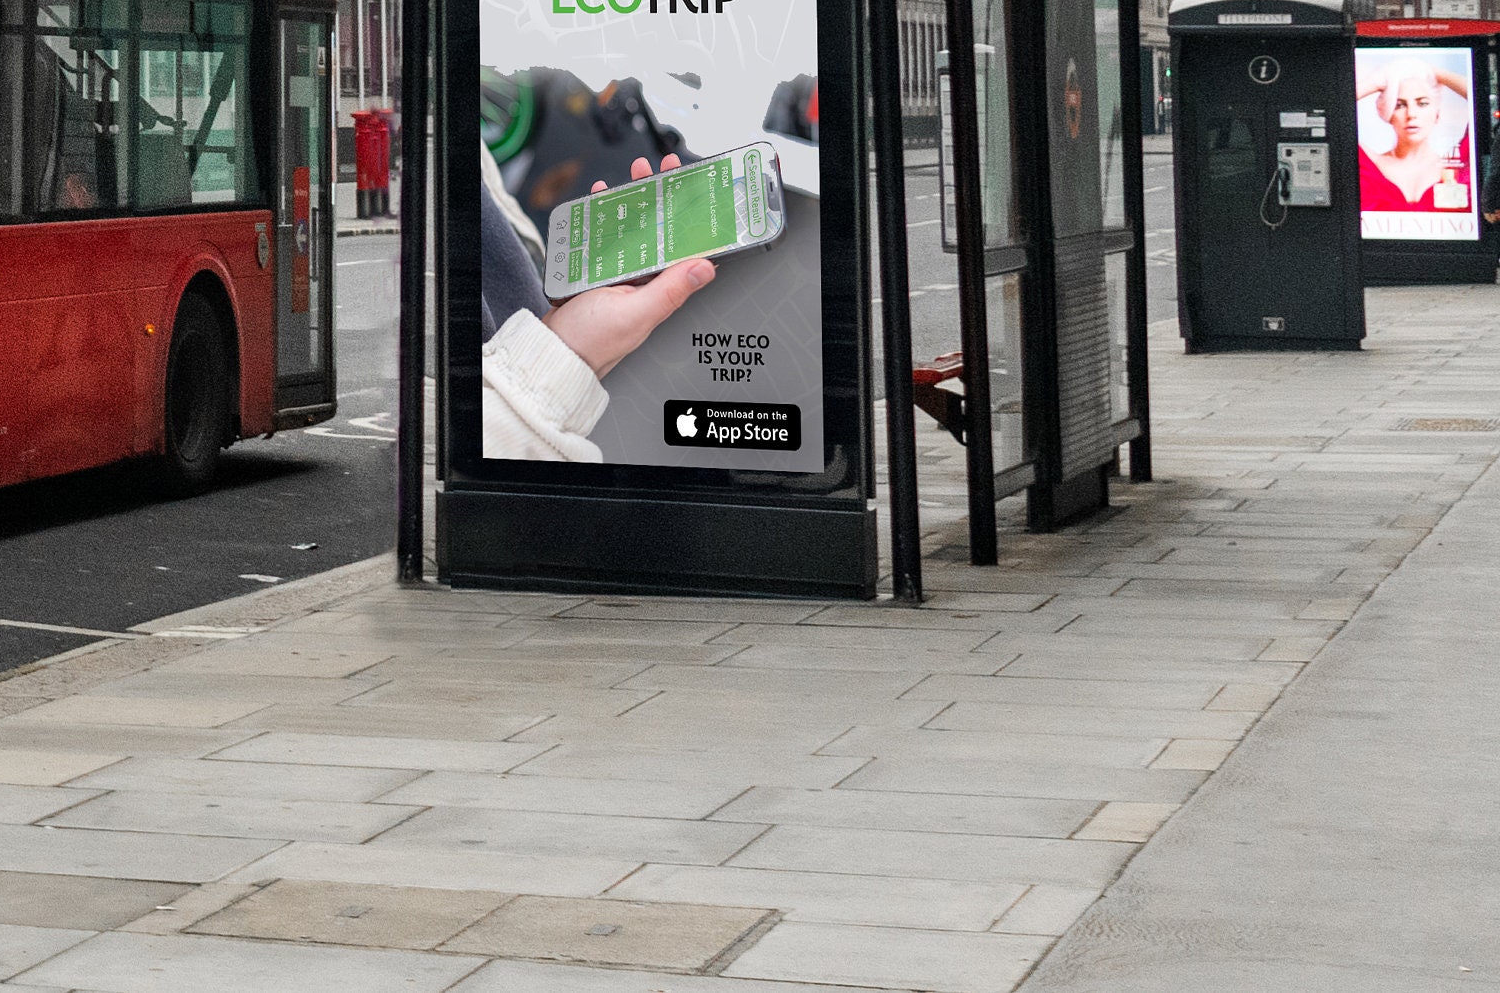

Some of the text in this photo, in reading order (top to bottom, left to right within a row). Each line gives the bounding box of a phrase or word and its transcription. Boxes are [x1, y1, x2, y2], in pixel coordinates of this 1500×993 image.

[675, 180, 682, 190] To
[721, 166, 729, 188] FROM
[749, 164, 763, 226] Search Result
[708, 177, 719, 238] Current Location
[639, 212, 648, 230] Walk
[596, 228, 605, 248] Cycle
[667, 220, 675, 254] Leicester
[640, 250, 648, 265] Min
[595, 262, 603, 278] Min
[617, 259, 625, 275] Min
[692, 333, 770, 349] HOW ECO
[698, 350, 765, 366] IS YOUR
[710, 368, 752, 382] TRIP?
[707, 408, 788, 421] Download on the
[706, 421, 789, 444] App Store
